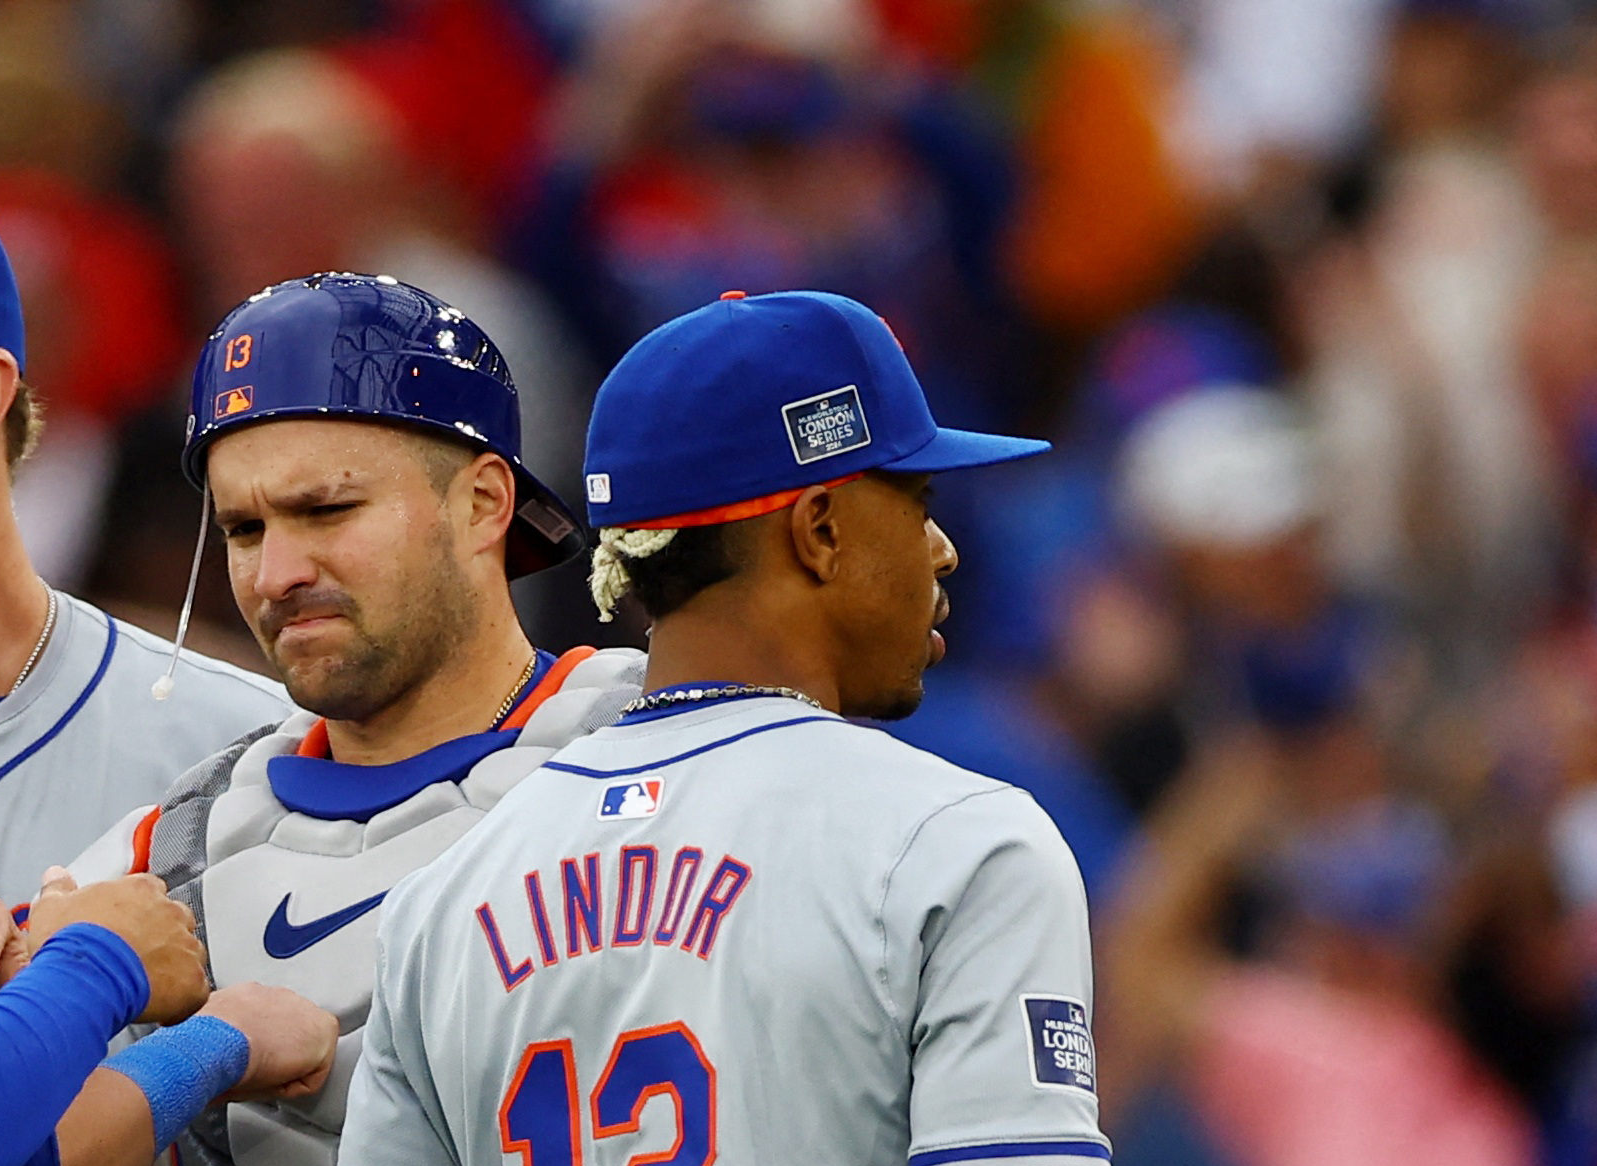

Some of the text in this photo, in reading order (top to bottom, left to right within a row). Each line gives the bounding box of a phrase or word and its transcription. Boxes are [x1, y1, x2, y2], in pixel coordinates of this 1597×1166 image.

[225, 334, 253, 372] 13
[798, 409, 855, 437] LONDON
[807, 424, 854, 448] SERIES
[475, 845, 752, 993] LINDOR
